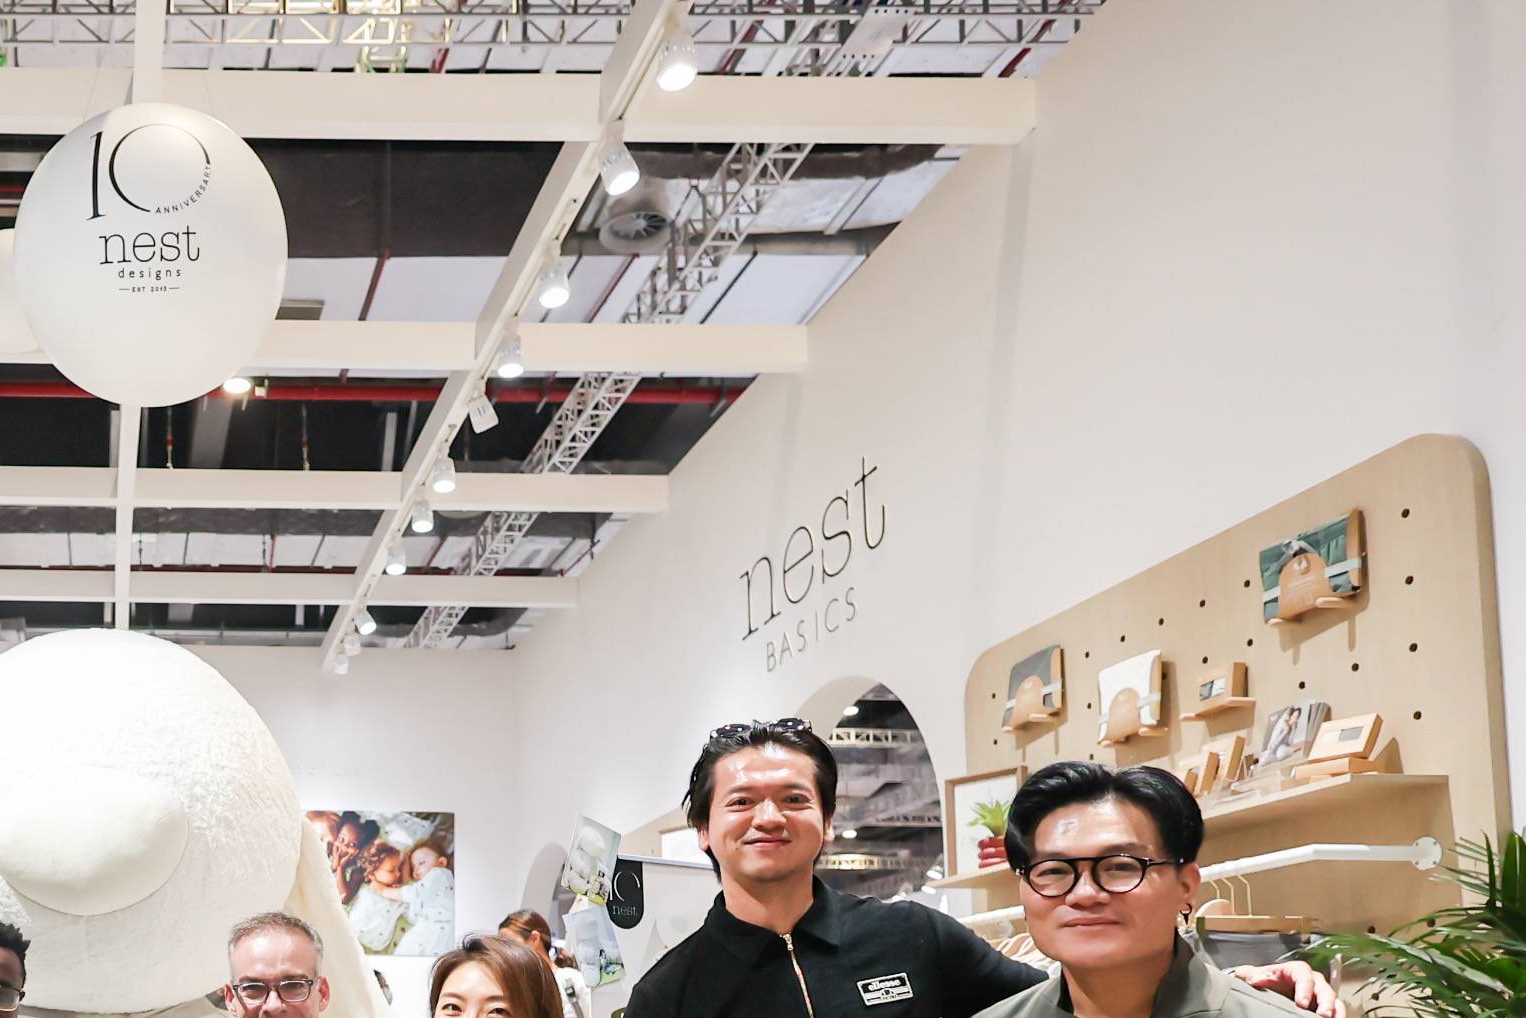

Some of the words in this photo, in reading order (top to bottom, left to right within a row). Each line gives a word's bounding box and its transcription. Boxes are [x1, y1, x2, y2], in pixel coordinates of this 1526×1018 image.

[155, 165, 212, 214] ANNIVERSARY
[99, 225, 201, 265] nest
[118, 266, 182, 281] designs
[739, 456, 886, 641] nest
[766, 586, 857, 673] BASICS
[867, 978, 902, 992] ellesse
